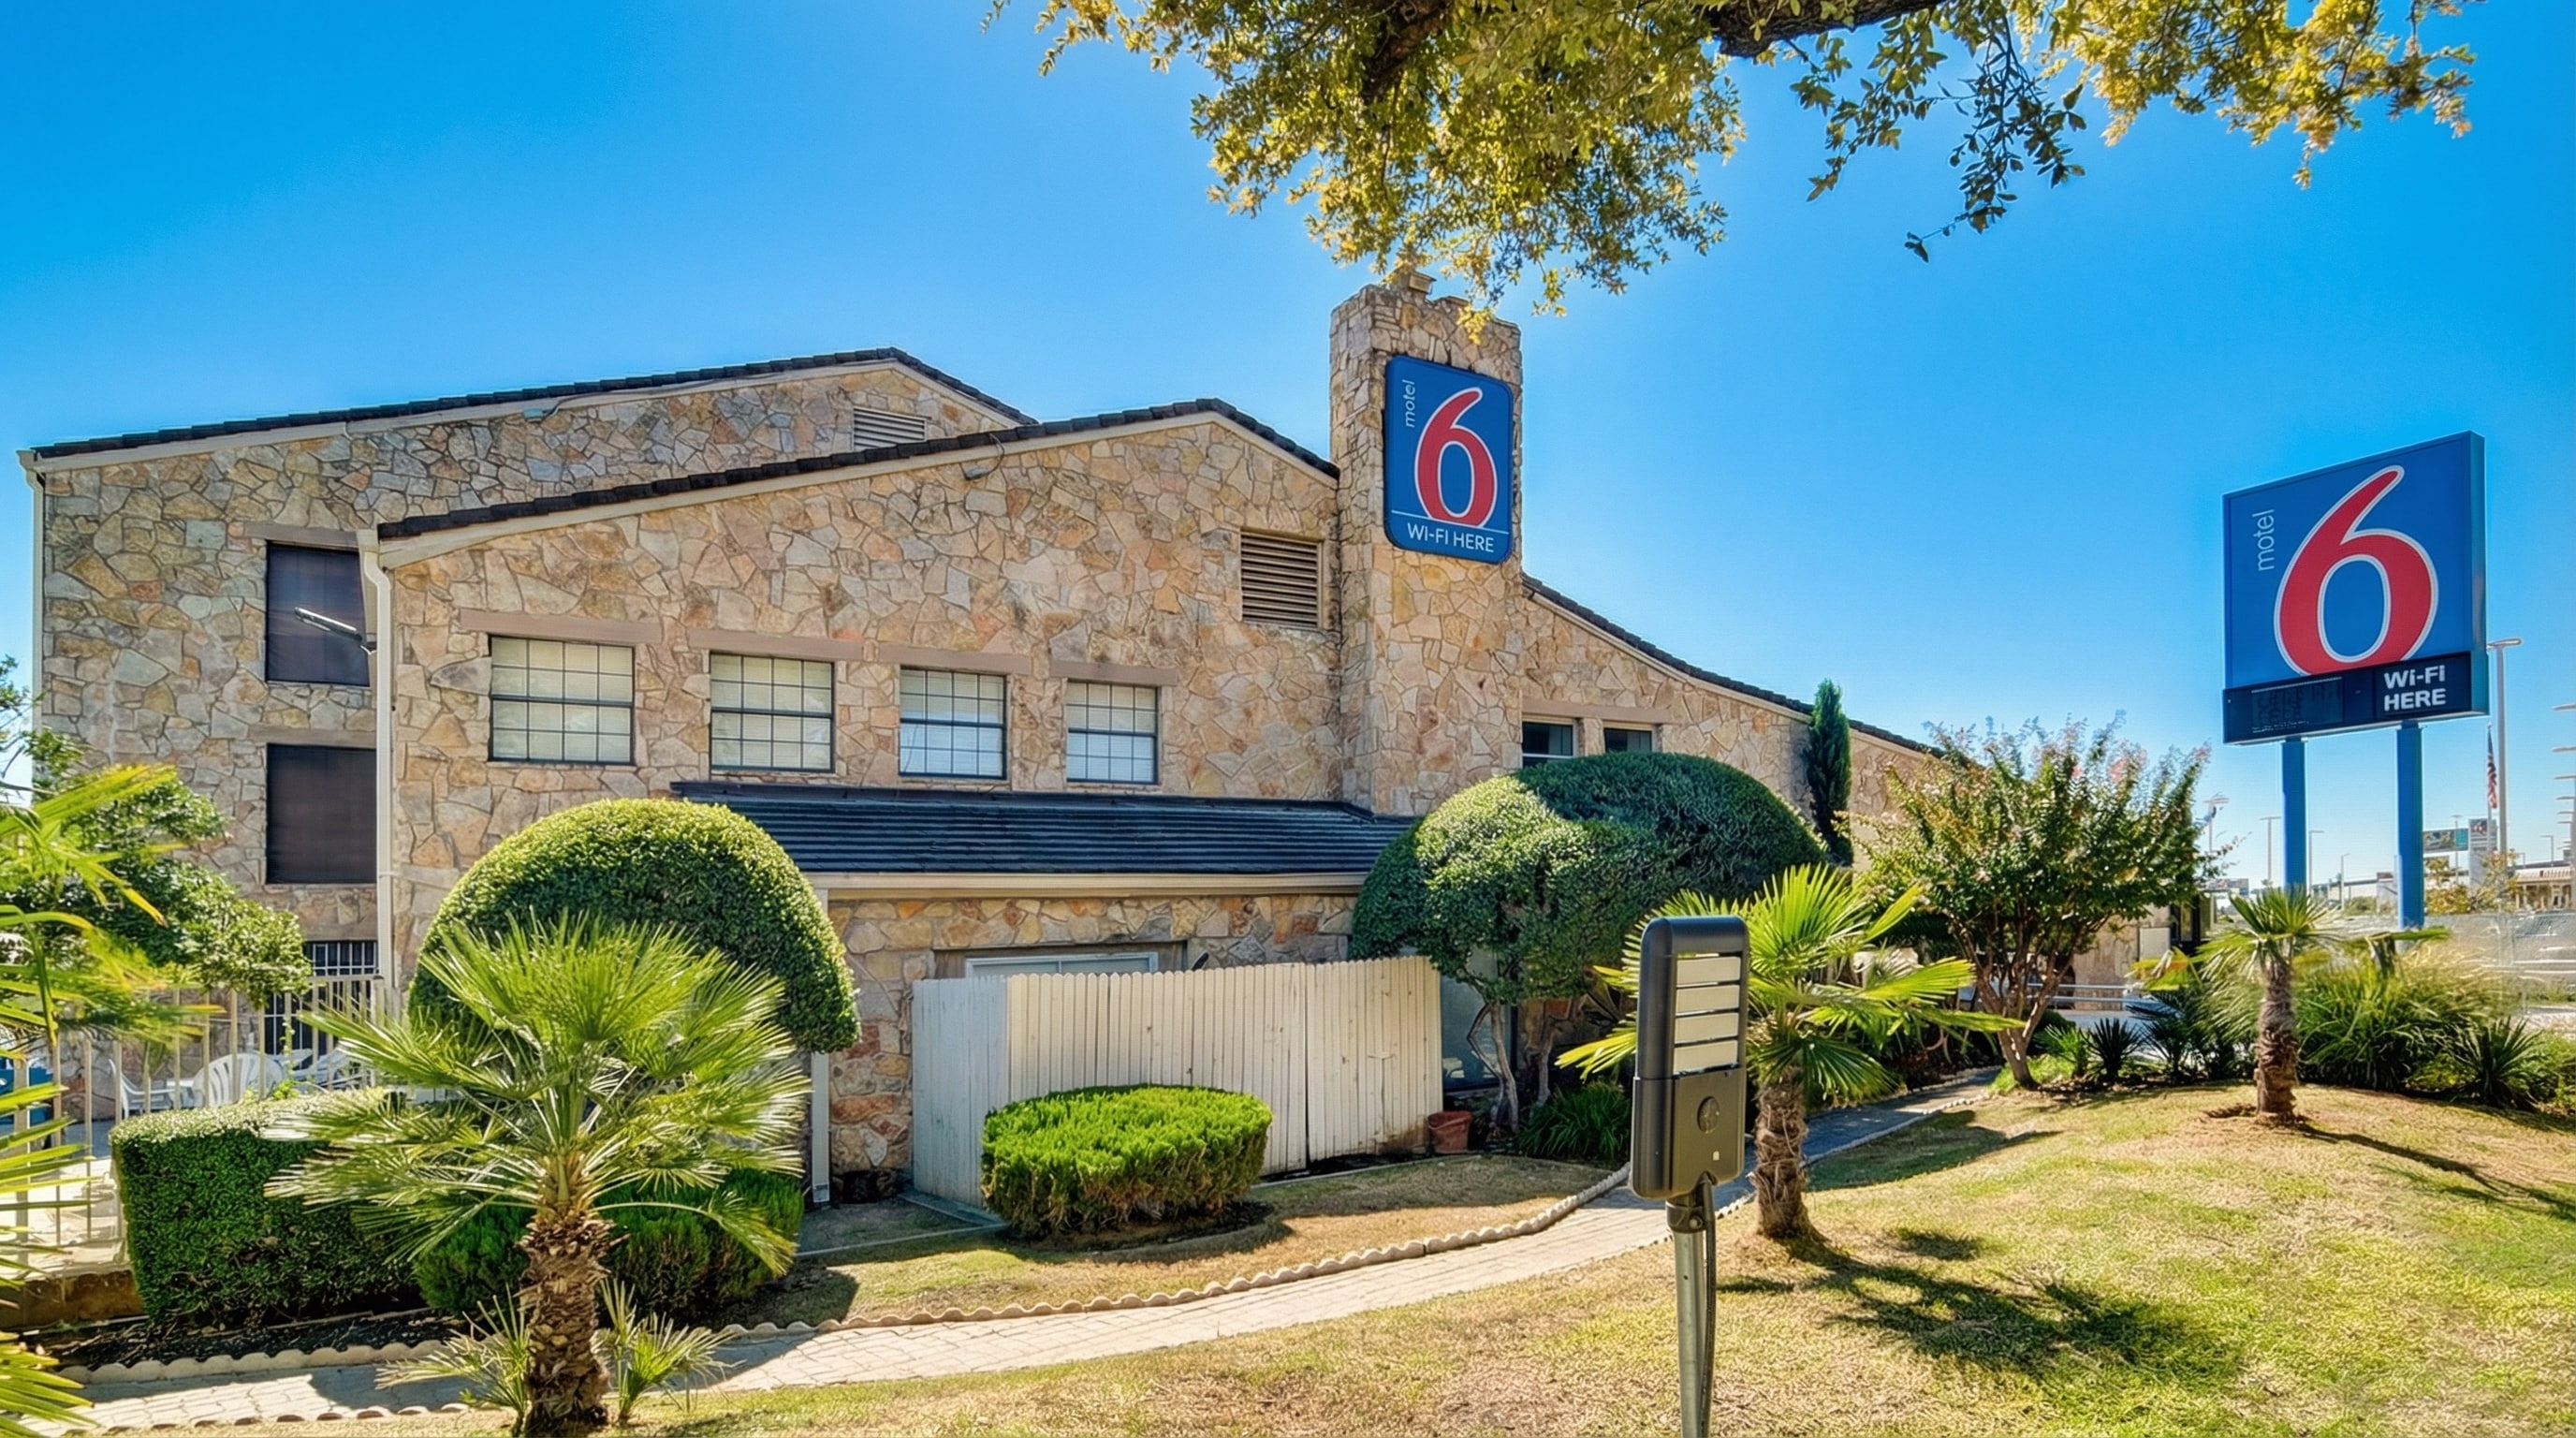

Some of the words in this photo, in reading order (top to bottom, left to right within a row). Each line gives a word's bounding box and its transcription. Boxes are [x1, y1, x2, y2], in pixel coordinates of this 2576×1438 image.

[1401, 379, 1416, 428] motel
[1414, 387, 1498, 527] 6
[1407, 522, 1449, 545] WI-FI
[1453, 534, 1495, 553] HERE
[2251, 508, 2275, 572] motel
[2274, 464, 2439, 676] 6
[2383, 664, 2446, 690] Wi-Fi
[2384, 688, 2447, 712] HERE
